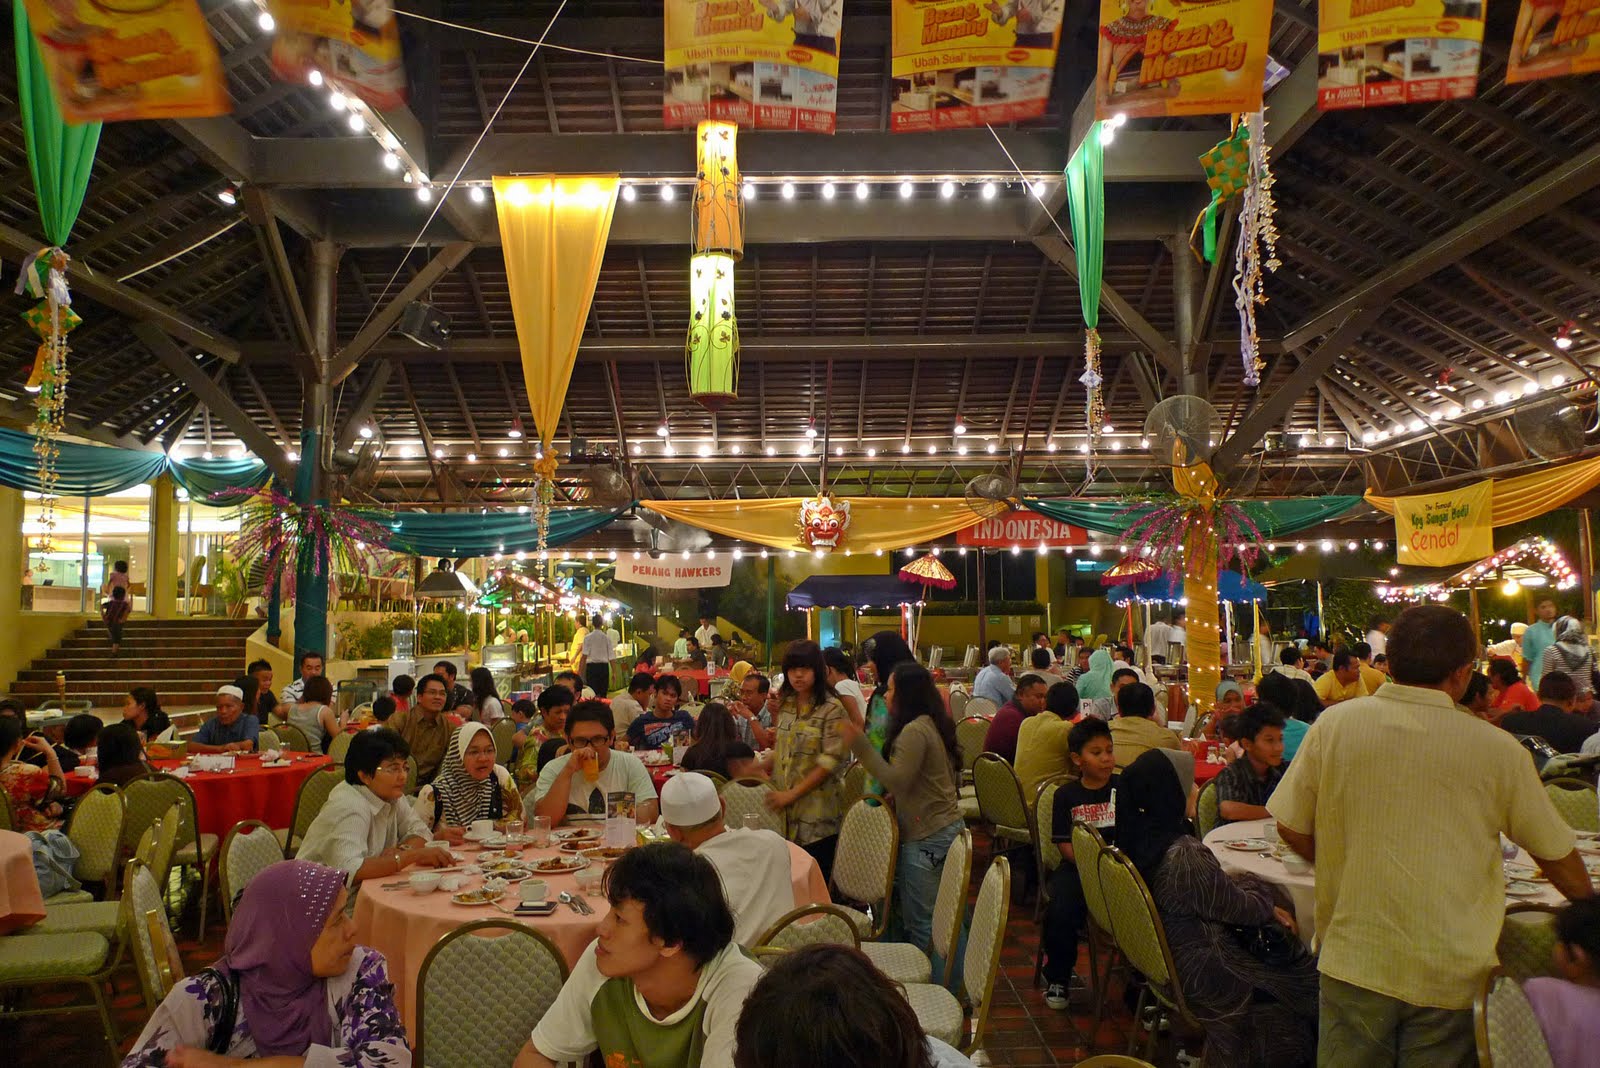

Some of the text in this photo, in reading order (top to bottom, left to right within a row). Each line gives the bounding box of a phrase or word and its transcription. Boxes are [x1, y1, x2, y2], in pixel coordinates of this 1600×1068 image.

[921, 18, 989, 45] Menang
[1139, 42, 1248, 86] Menang
[973, 519, 1072, 539] INDONESIA
[1411, 523, 1459, 551] Cendol
[632, 565, 721, 578] PENANG HAWKERS
